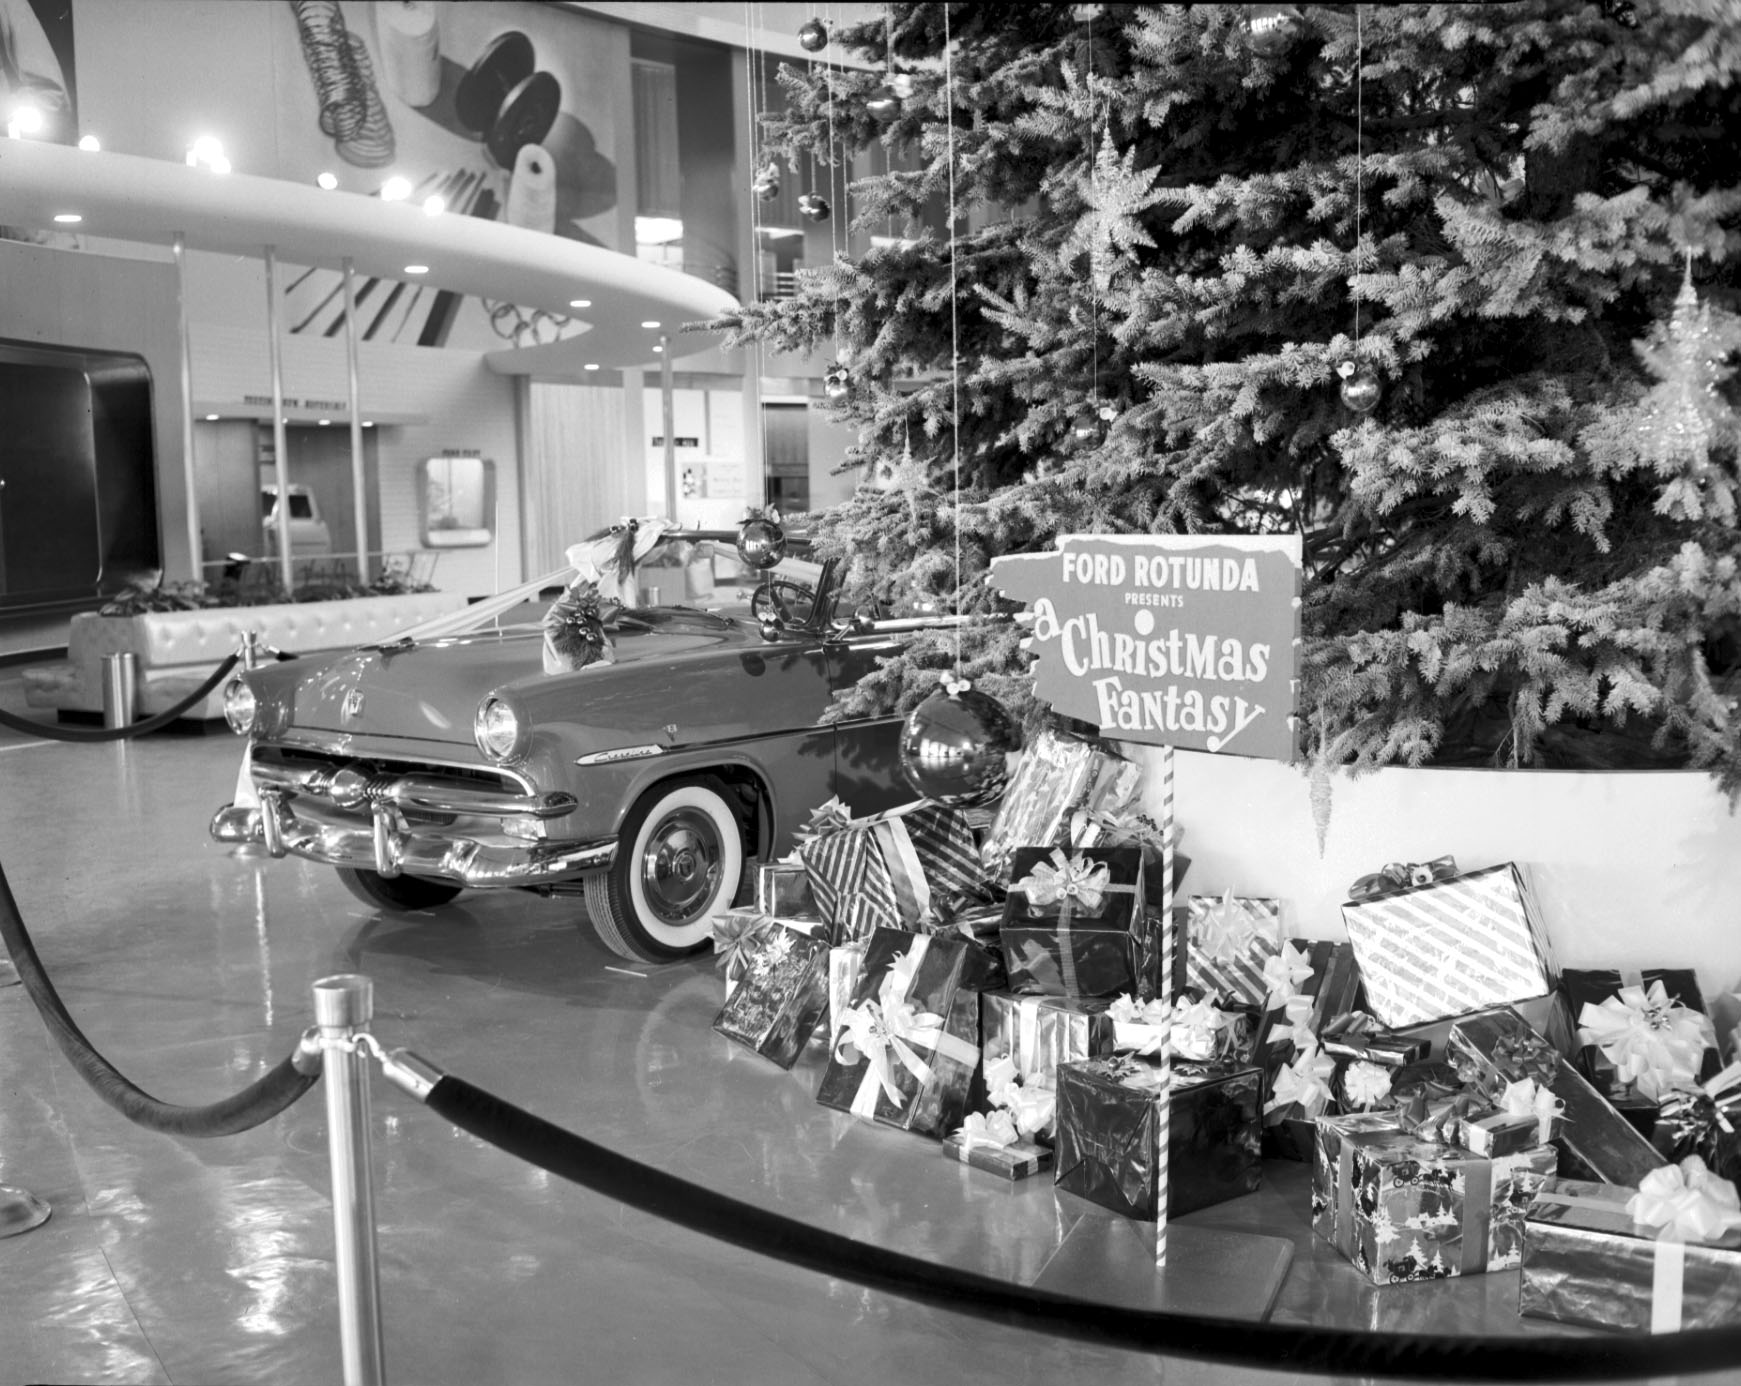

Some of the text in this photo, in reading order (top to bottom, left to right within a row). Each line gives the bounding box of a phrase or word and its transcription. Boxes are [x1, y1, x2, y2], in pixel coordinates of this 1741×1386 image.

[1062, 552, 1260, 592] FORD ROTUNDA
[1124, 592, 1184, 608] PRESENTS
